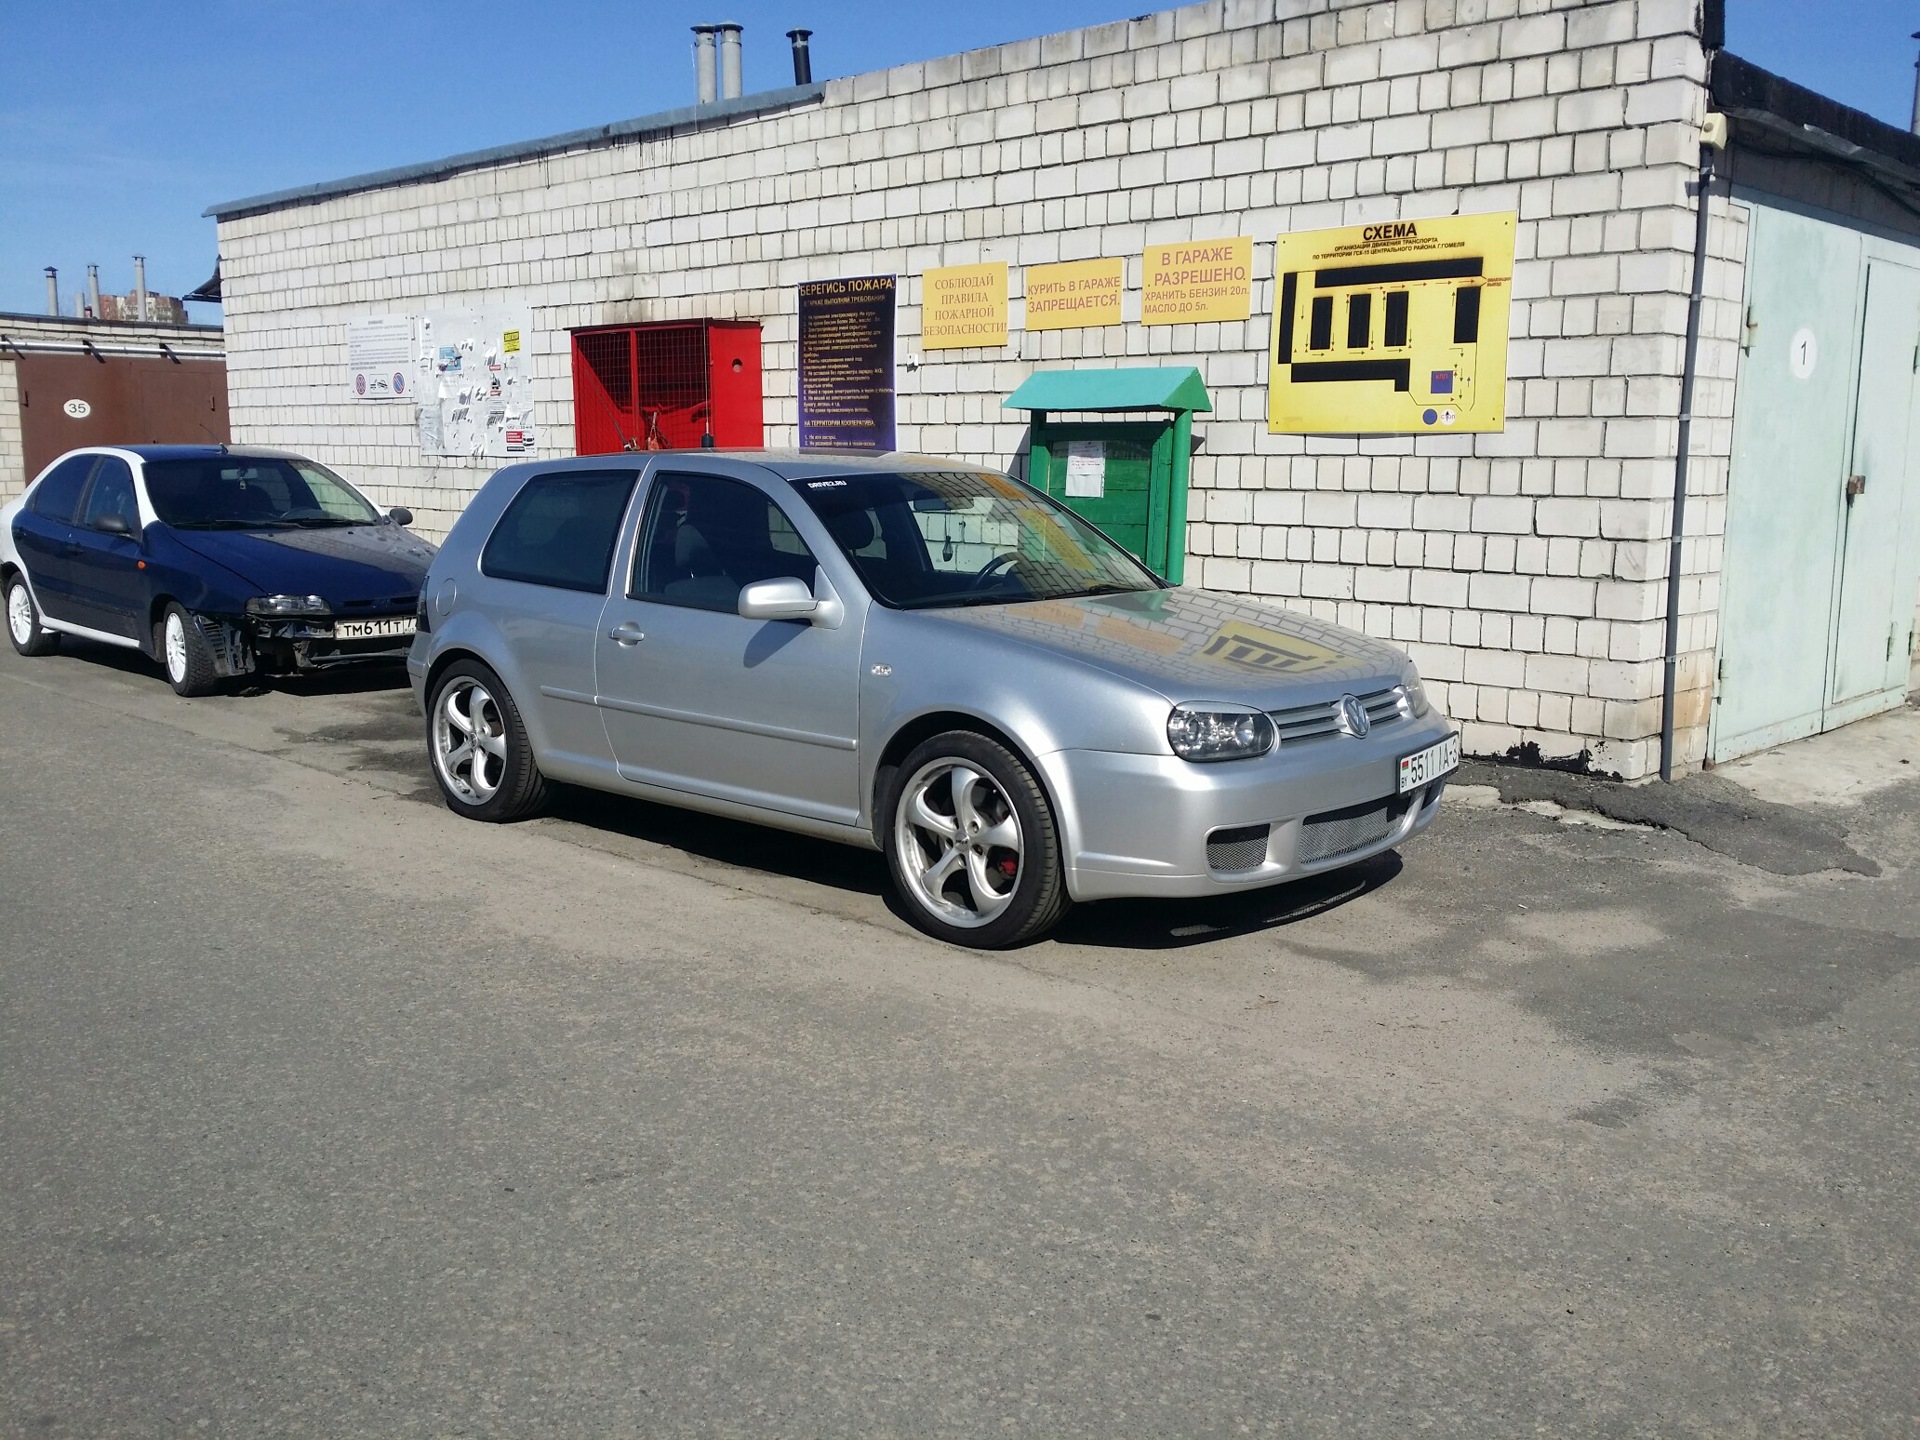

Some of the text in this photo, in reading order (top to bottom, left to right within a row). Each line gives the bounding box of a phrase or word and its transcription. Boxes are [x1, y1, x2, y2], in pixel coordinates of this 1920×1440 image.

[1362, 222, 1417, 240] СХЕМА
[1402, 237, 1438, 245] ТРАНСПОРТА
[1161, 246, 1233, 266] В ГАРАЖЕ
[1321, 251, 1352, 259] ТЕРРИТОРИИ
[1370, 246, 1412, 256] ЦЕНТРАЛЬНОГО
[1413, 243, 1437, 251] РАЙОНА
[800, 281, 846, 297] БЕРЕГИСЬ
[934, 272, 994, 290] СОБЛЮДАЙ
[1028, 276, 1120, 295] КУРИТЬ В ГАРАЖЕ
[941, 292, 989, 305] ПРАВИЛА
[1144, 290, 1187, 301] ХРАНИТЬ
[1189, 286, 1228, 299] БЕНЗИН
[1028, 294, 1120, 313] ЗАПРЕЩАЕТСЯ.
[1144, 303, 1177, 314] МАСЛО
[1178, 302, 1193, 313] ДО
[934, 304, 995, 321] ПОЖАРНОЙ
[923, 322, 1007, 337] БЕЗОПАСНОСТИ!
[1801, 340, 1807, 365] 1
[68, 403, 86, 413] 35
